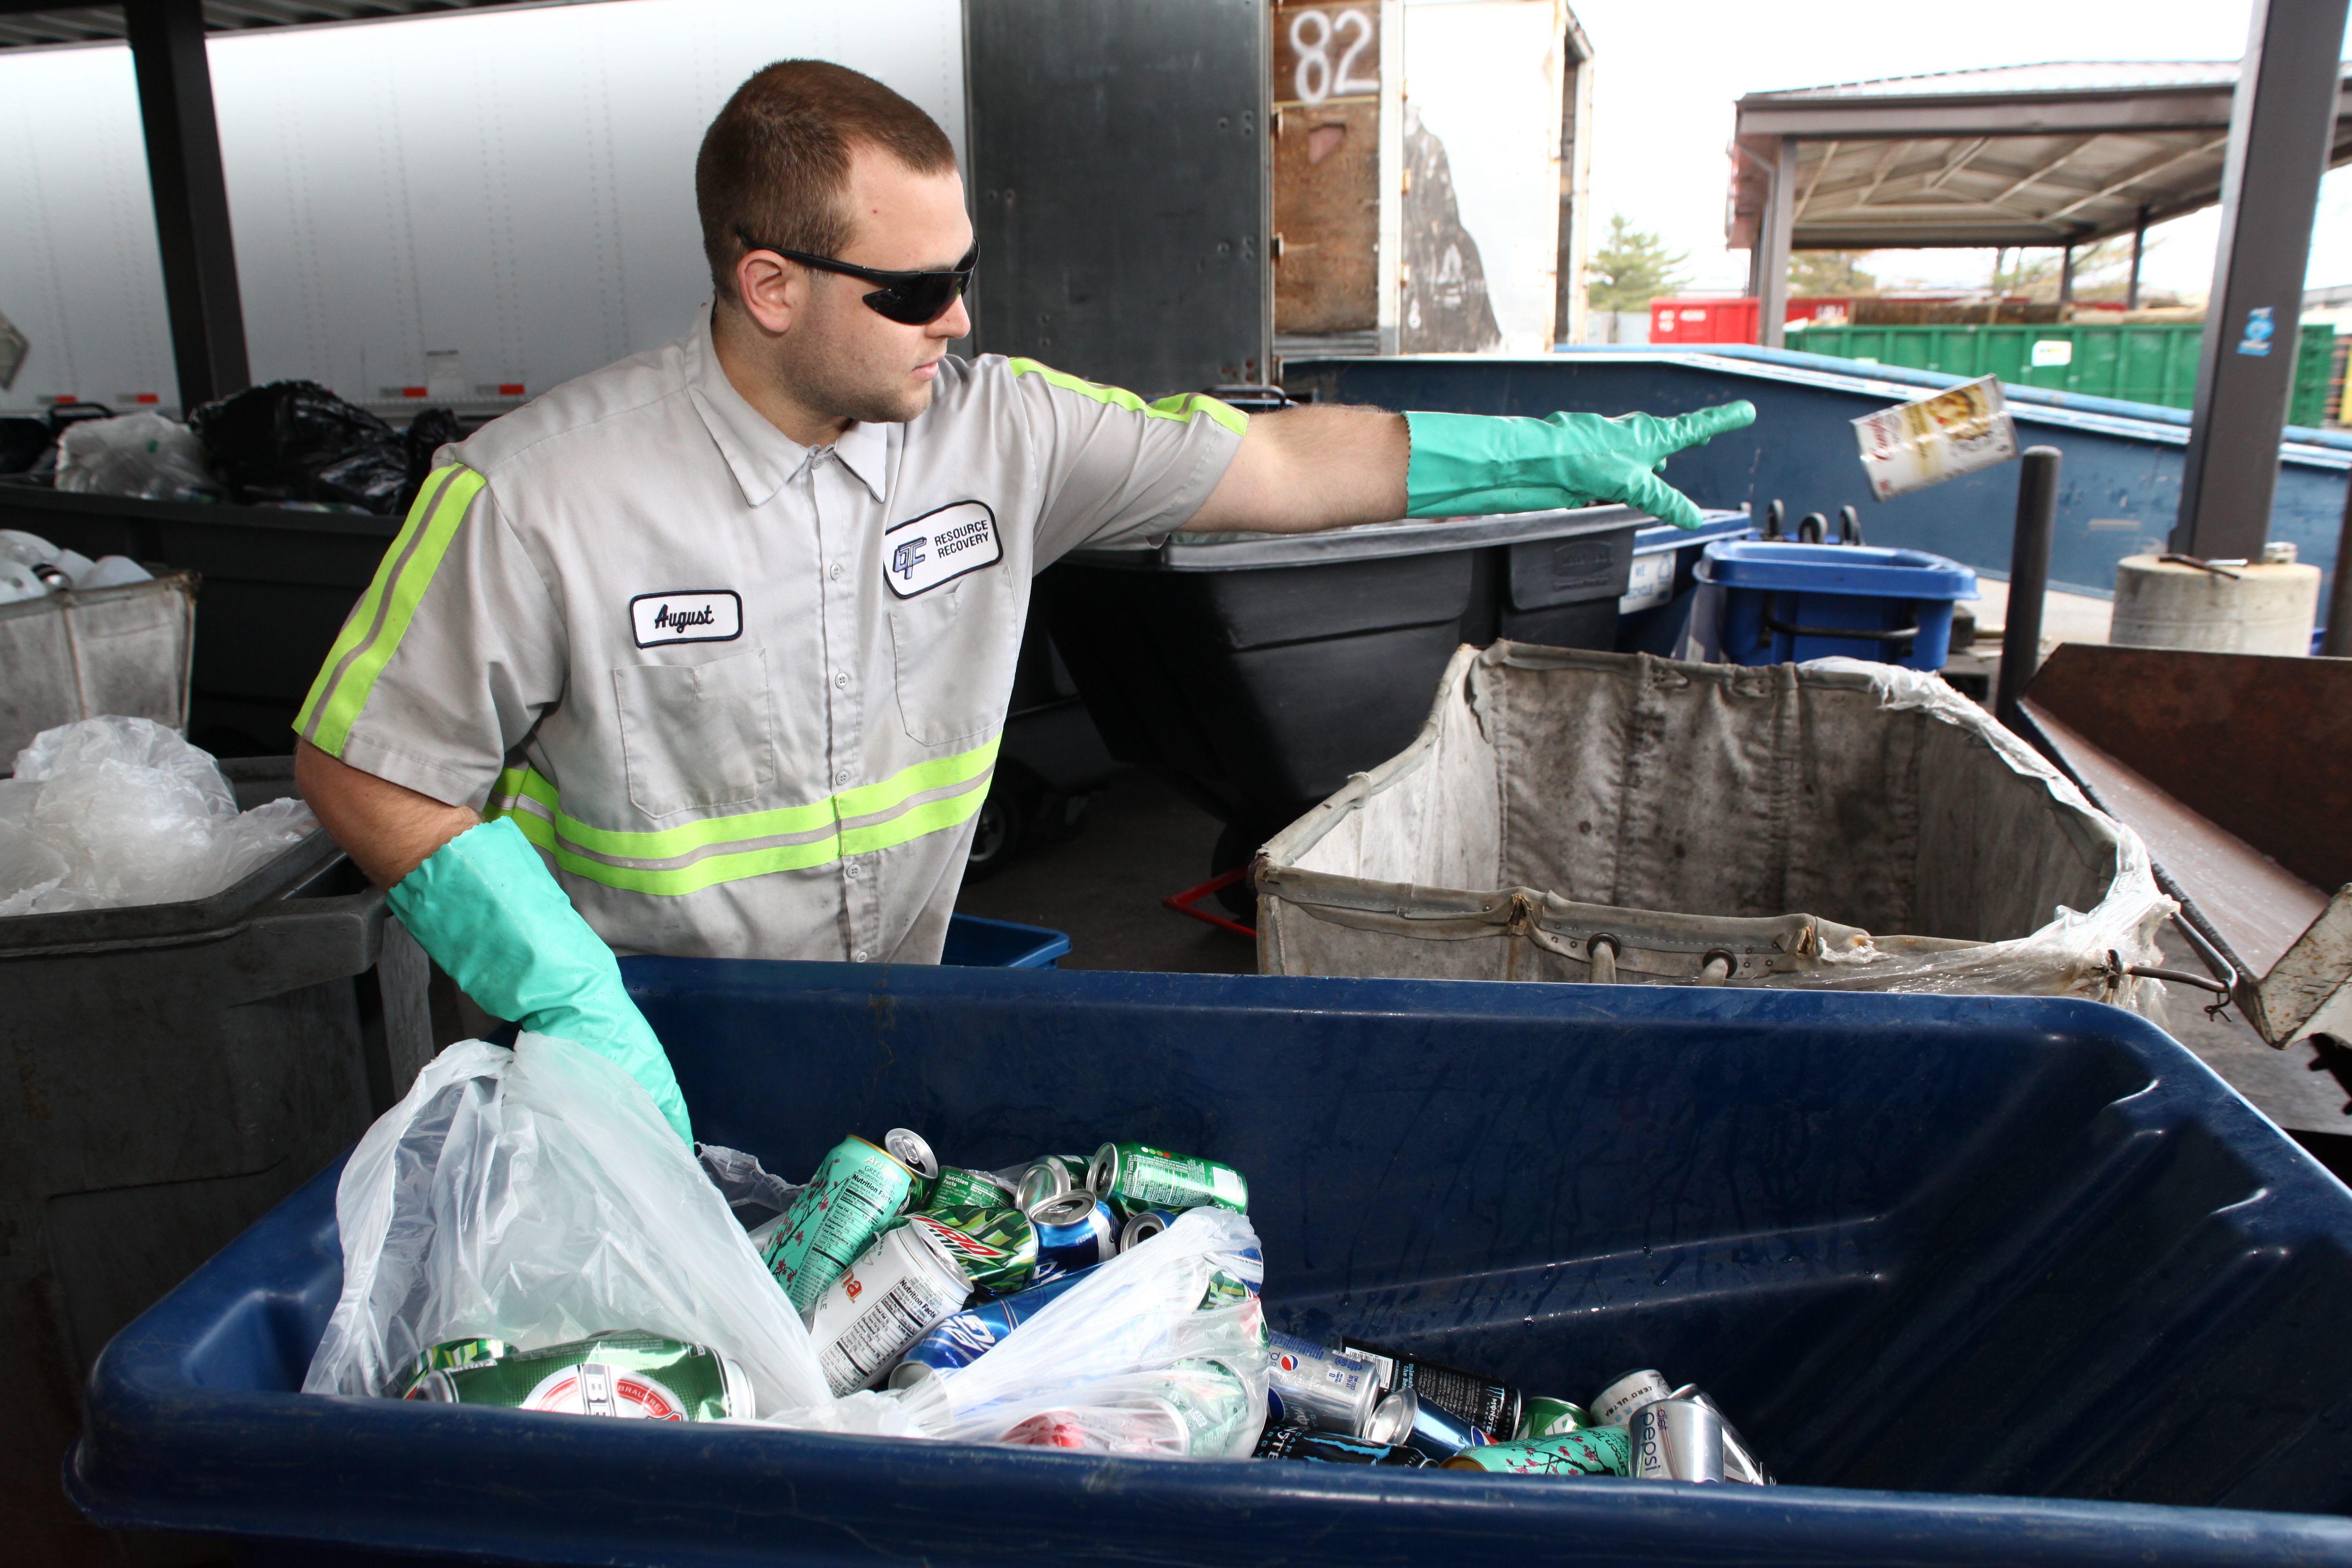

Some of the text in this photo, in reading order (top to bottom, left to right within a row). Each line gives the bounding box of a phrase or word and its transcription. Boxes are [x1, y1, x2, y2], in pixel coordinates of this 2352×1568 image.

[1290, 9, 1379, 103] 82
[934, 520, 988, 547] RESOURCE
[937, 532, 989, 559] RECOVERY
[654, 603, 714, 634] August
[850, 1180, 860, 1189] Serving
[864, 1164, 896, 1189] GREEN TEA
[864, 1173, 879, 1184] GINSENG
[943, 1179, 957, 1187] Facts
[945, 1173, 969, 1186] Nutrition
[1124, 1173, 1132, 1194] Nutrition
[848, 1183, 859, 1193] Servings
[851, 1173, 893, 1204] Nutrition Facts
[841, 1194, 854, 1204] Calories
[827, 1217, 844, 1229] Cholesterol
[801, 1222, 823, 1261] PRESERVATIVES
[828, 1230, 849, 1245] Carbohydrate
[892, 1288, 903, 1301] Servings
[895, 1285, 905, 1297] Serving
[899, 1279, 937, 1318] Nutrition Facts
[915, 1284, 930, 1300] ARTIFICIAL
[918, 1282, 934, 1298] ARTIFICIAL
[932, 1297, 942, 1307] COLOR
[923, 1281, 944, 1302] PRESERVATIVES
[871, 1311, 882, 1324] Saturated
[874, 1305, 882, 1314] Total
[882, 1297, 908, 1326] Calories Calories
[856, 1321, 867, 1333] Sodium
[860, 1317, 876, 1335] Cholesterol
[839, 1337, 849, 1349] Protein
[845, 1335, 854, 1345] Sugars
[849, 1331, 858, 1341] Dietary
[851, 1325, 877, 1353] Total Carbohydrate
[828, 1348, 838, 1359] Calcium
[832, 1344, 841, 1355] Vitamin
[617, 1385, 663, 1413] BRAUEREI
[1604, 1385, 1653, 1417] ZERO ULTRA
[1485, 1398, 1498, 1435] MONSTER
[1656, 1408, 1669, 1432] diet
[1639, 1411, 1661, 1471] pepsi
[1586, 1429, 1628, 1478] Green Tea
